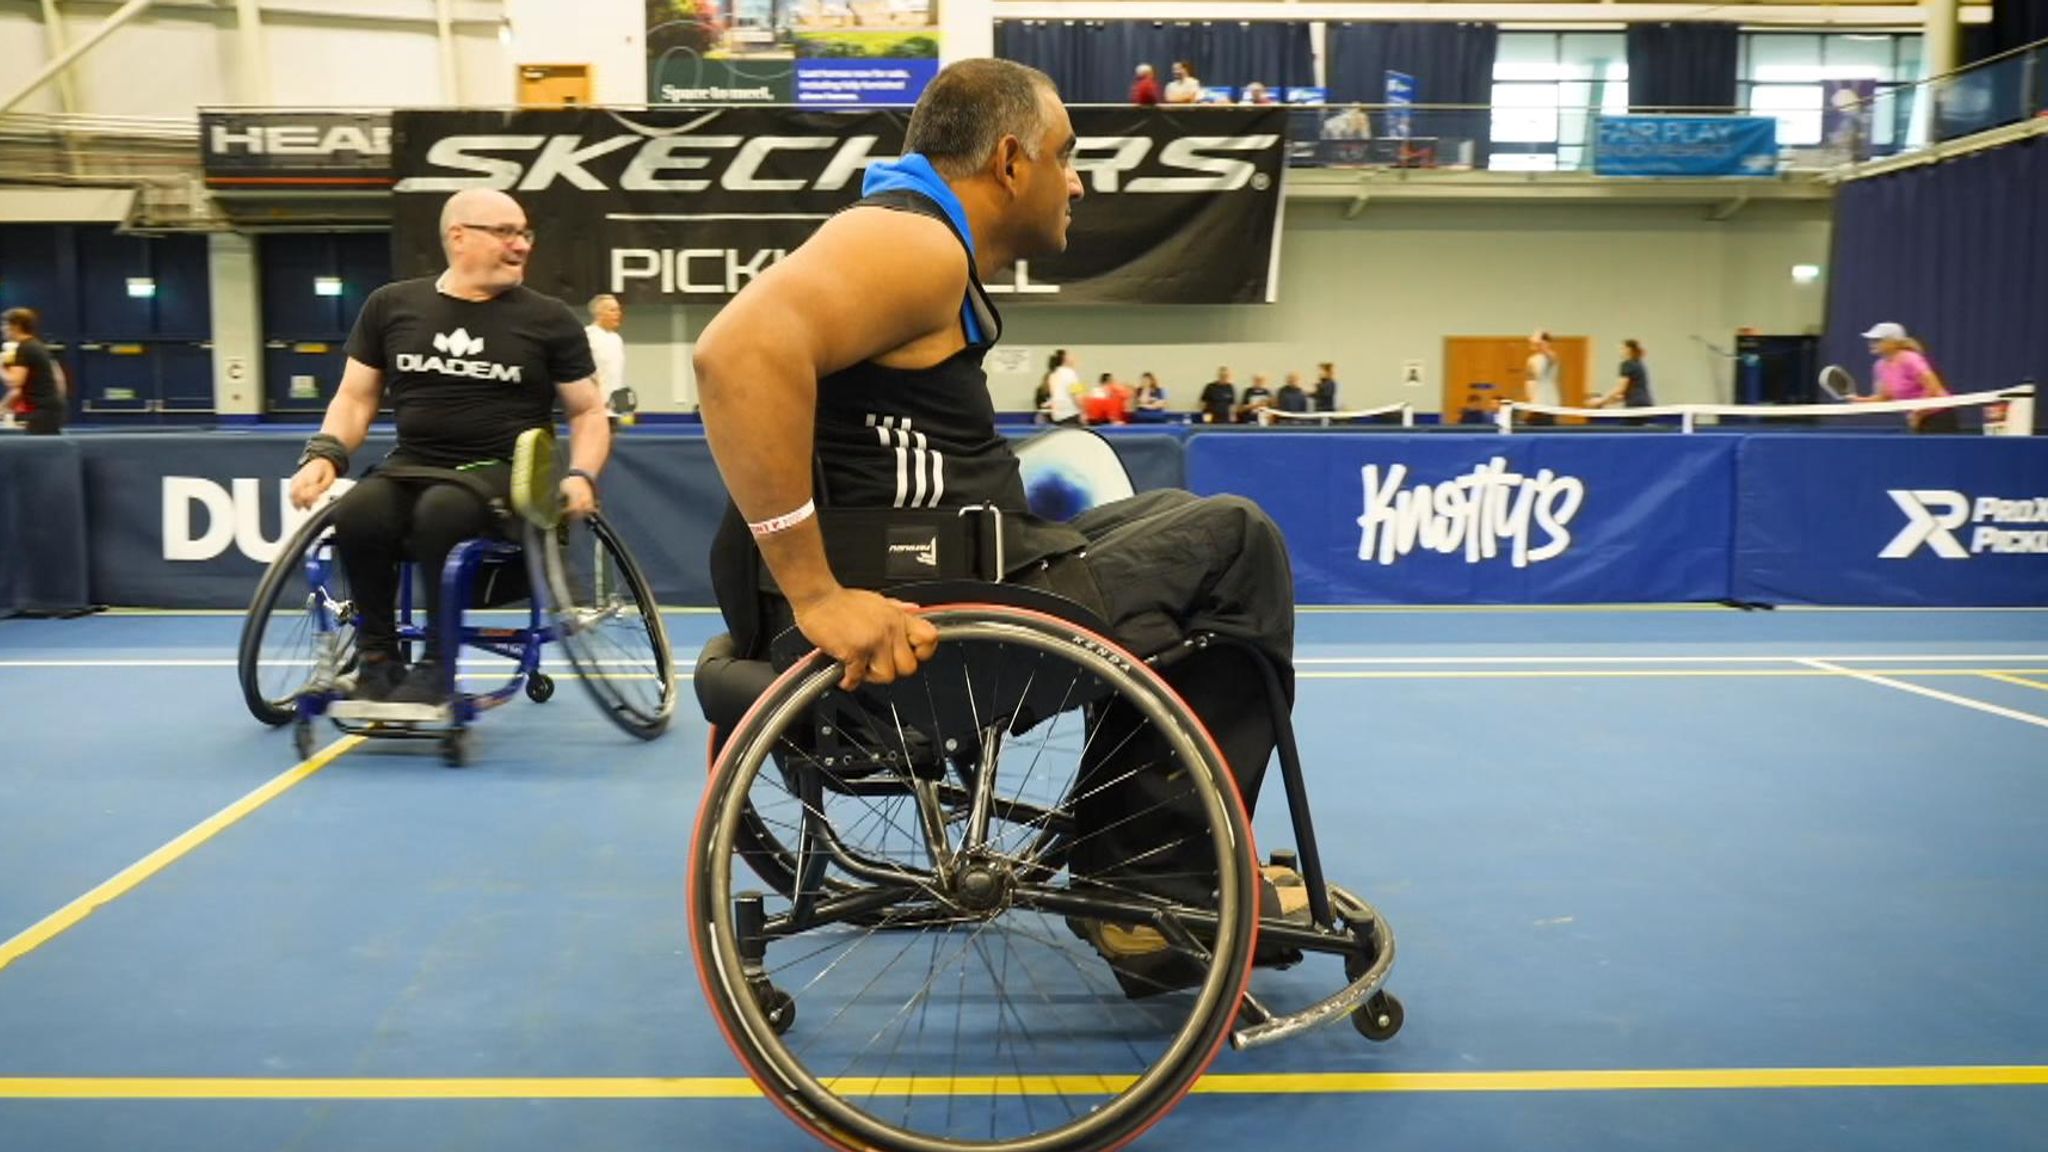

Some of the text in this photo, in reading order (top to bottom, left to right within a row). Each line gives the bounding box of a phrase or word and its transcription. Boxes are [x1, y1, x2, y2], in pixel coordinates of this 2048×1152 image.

[393, 134, 1279, 191] SKECHRS
[396, 352, 522, 383] DIADEM
[1071, 634, 1131, 674] KENDA
